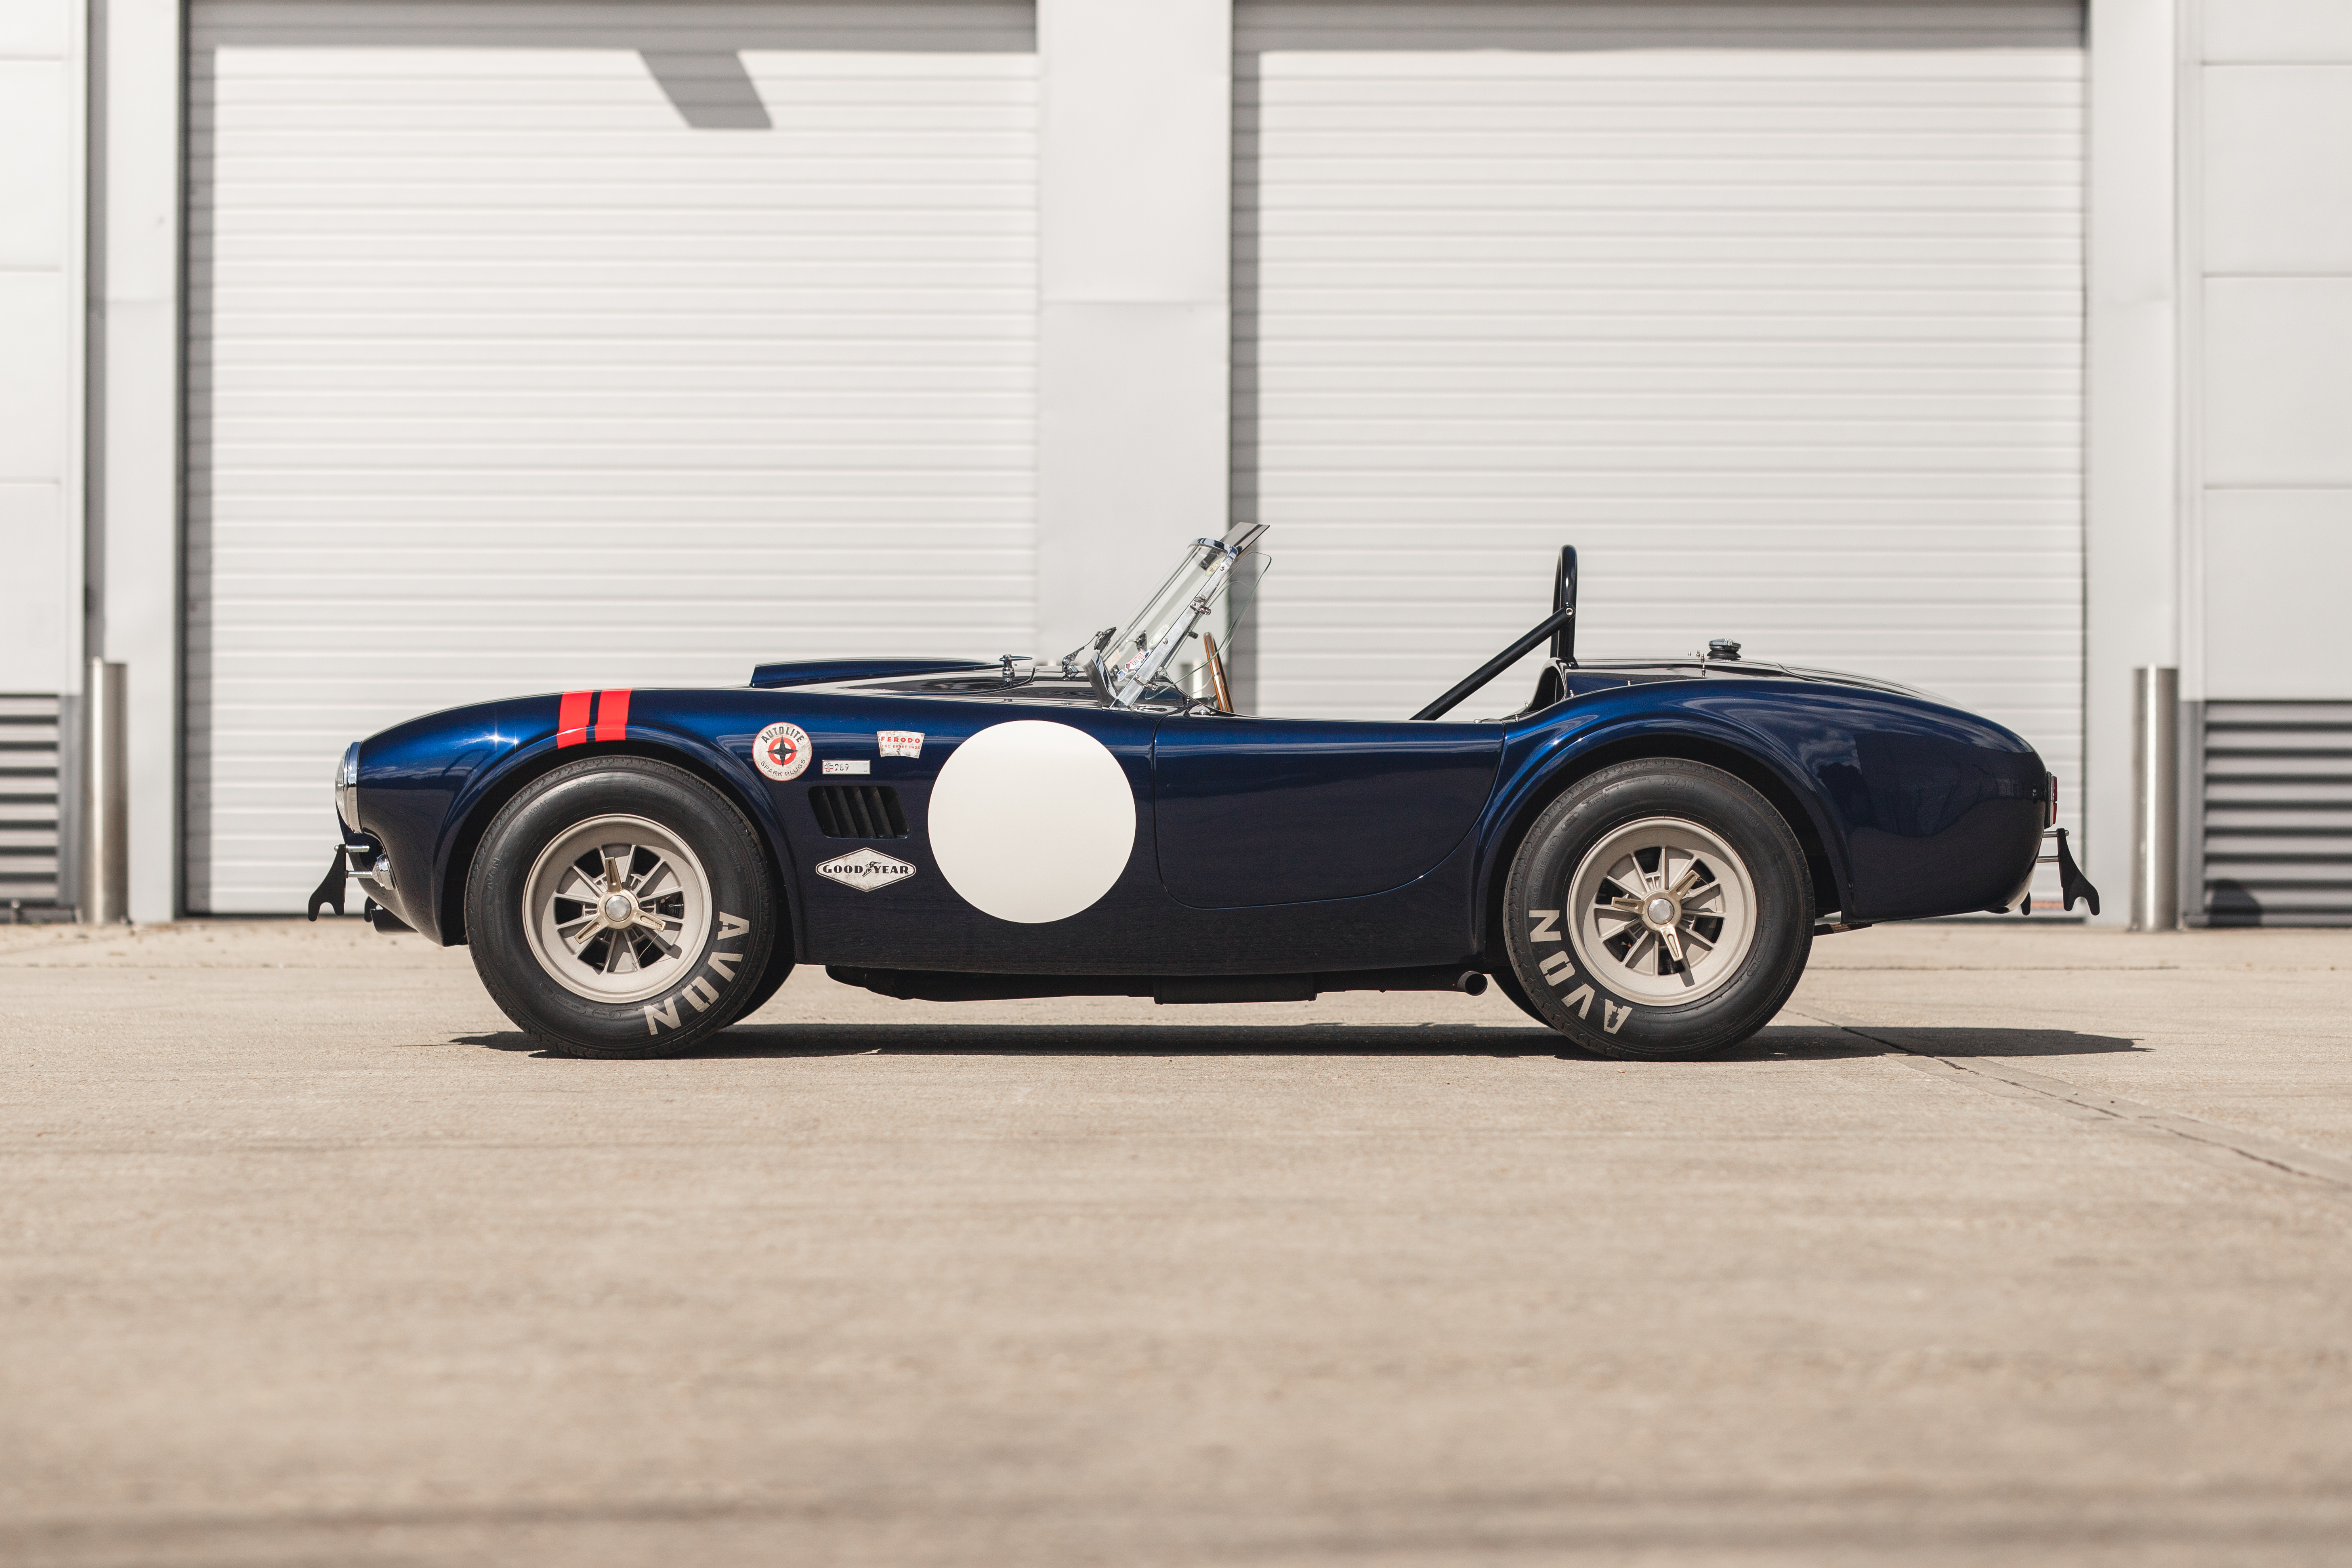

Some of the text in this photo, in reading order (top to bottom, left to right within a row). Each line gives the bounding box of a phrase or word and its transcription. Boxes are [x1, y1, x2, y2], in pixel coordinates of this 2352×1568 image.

[761, 726, 804, 743] AUTOLITE
[761, 759, 806, 777] SPARK PLUGS
[834, 763, 849, 771] 289
[1661, 778, 1695, 790] AVON
[523, 799, 550, 821] RADIAL
[643, 911, 750, 1036] AVON
[1529, 910, 1633, 1035] AVON
